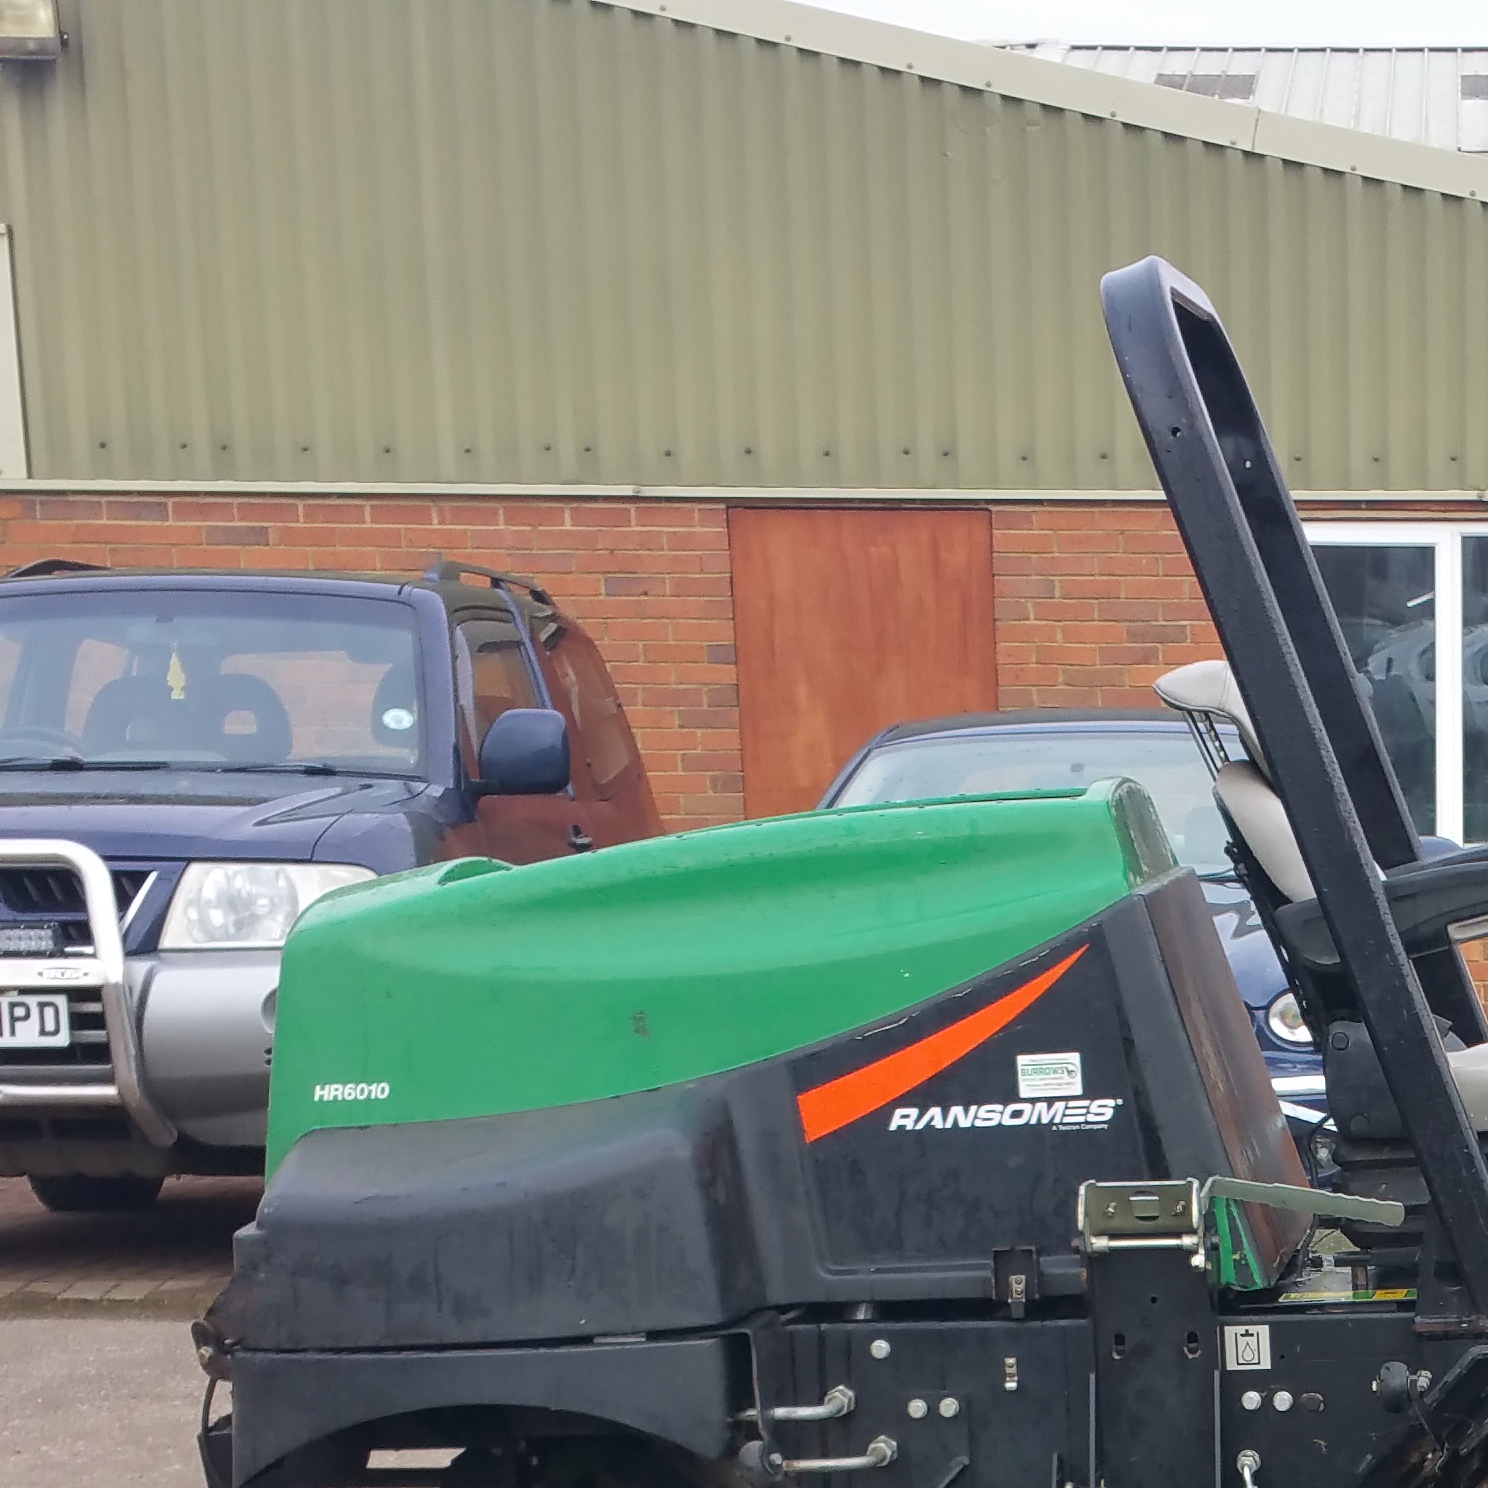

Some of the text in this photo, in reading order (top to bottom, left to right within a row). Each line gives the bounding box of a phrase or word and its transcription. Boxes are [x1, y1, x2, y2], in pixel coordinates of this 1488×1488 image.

[0, 1001, 60, 1038] PD
[1021, 1066, 1065, 1076] BURROWS
[313, 1082, 390, 1101] HR6010
[888, 1099, 1116, 1131] RANSOMES
